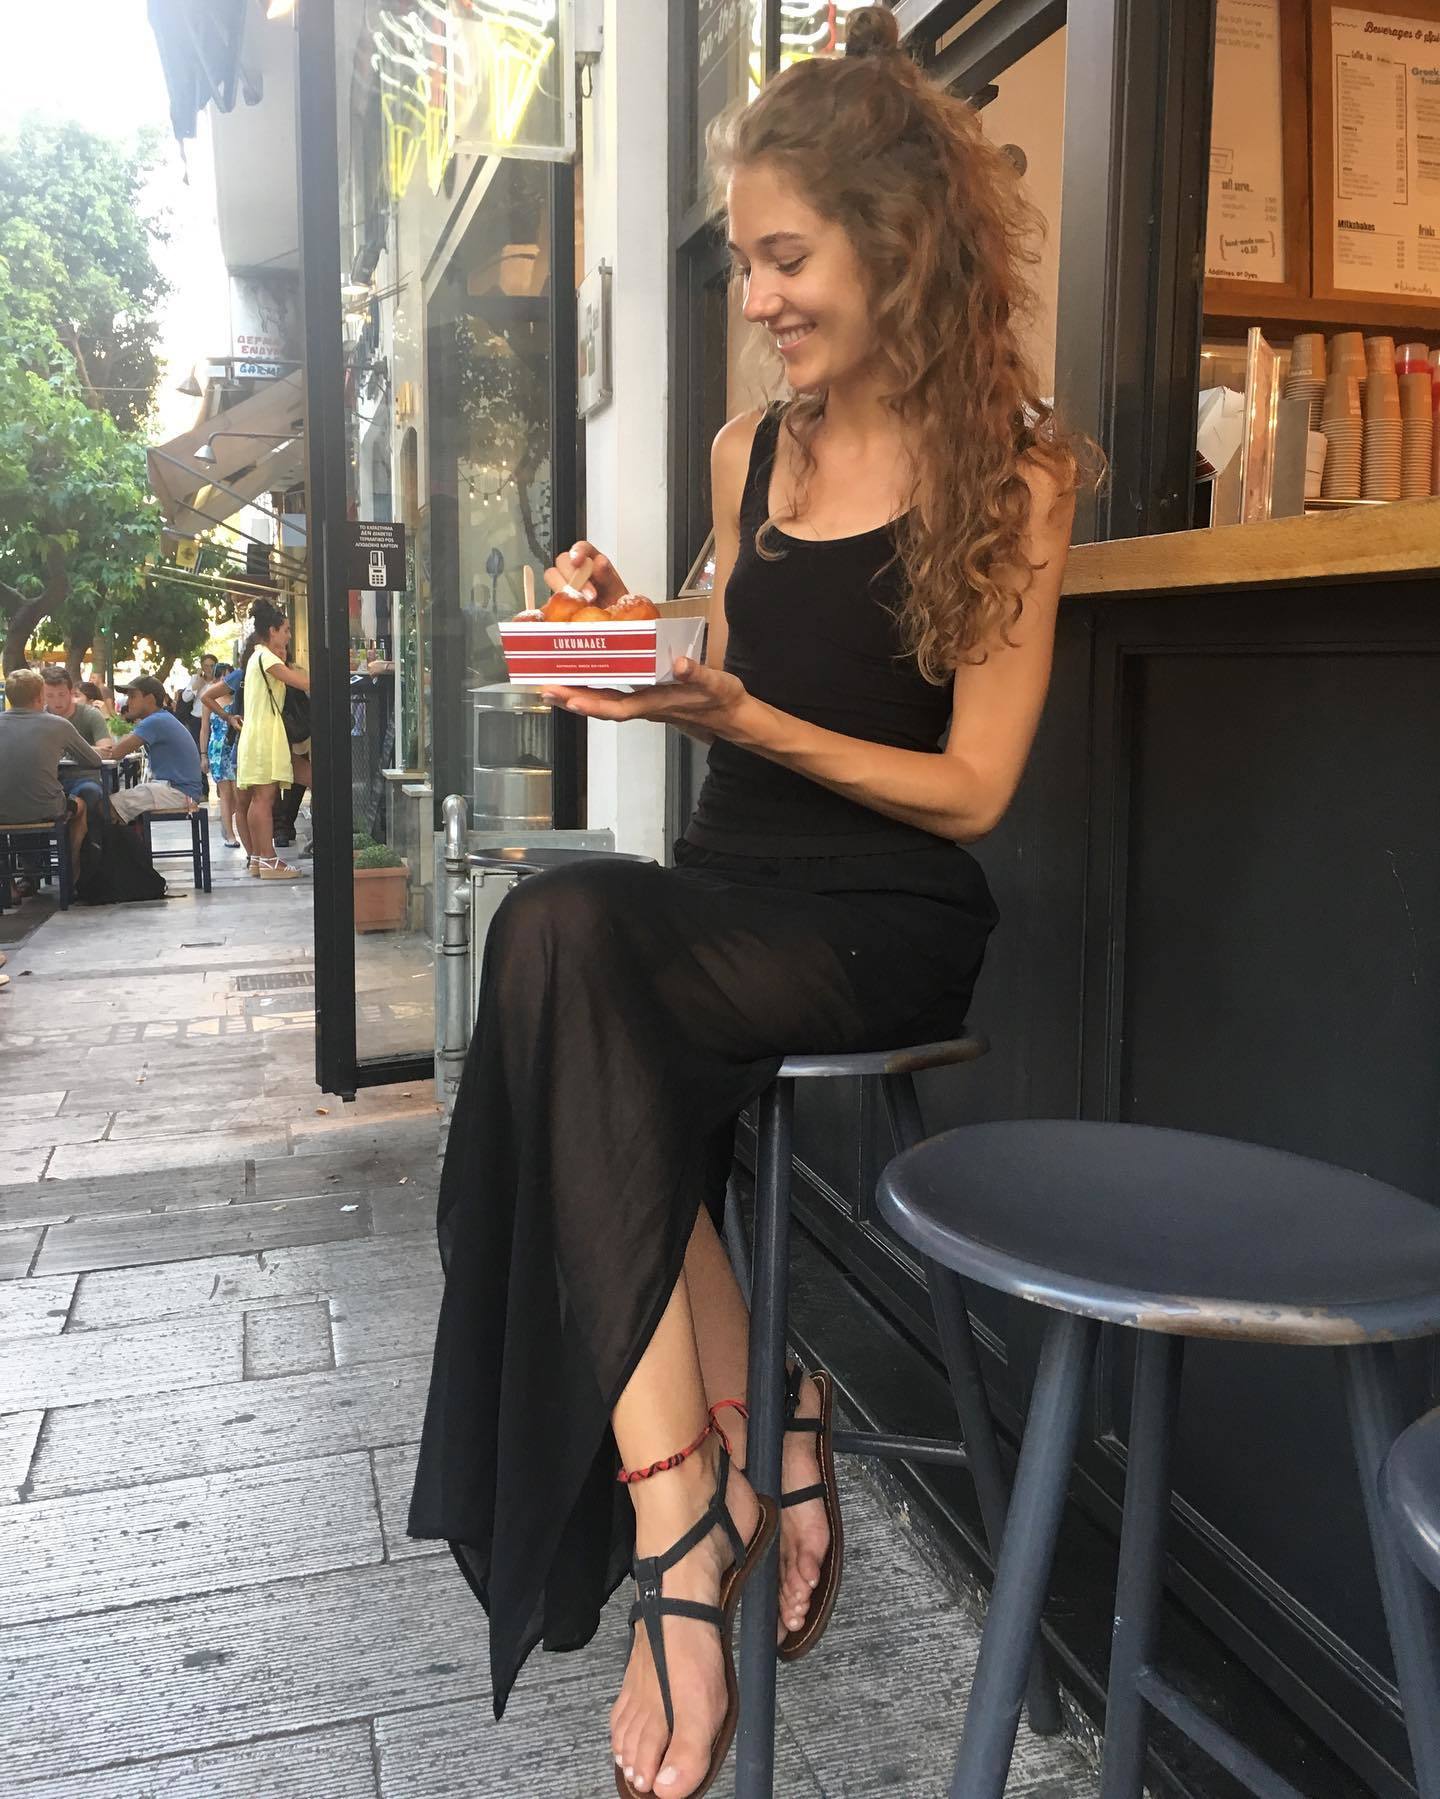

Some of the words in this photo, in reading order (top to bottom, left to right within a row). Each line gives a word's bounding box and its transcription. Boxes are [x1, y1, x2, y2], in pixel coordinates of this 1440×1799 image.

[1364, 21, 1413, 41] Beverages
[1337, 219, 1376, 232] Milkshakes
[1418, 223, 1436, 237] Drinks
